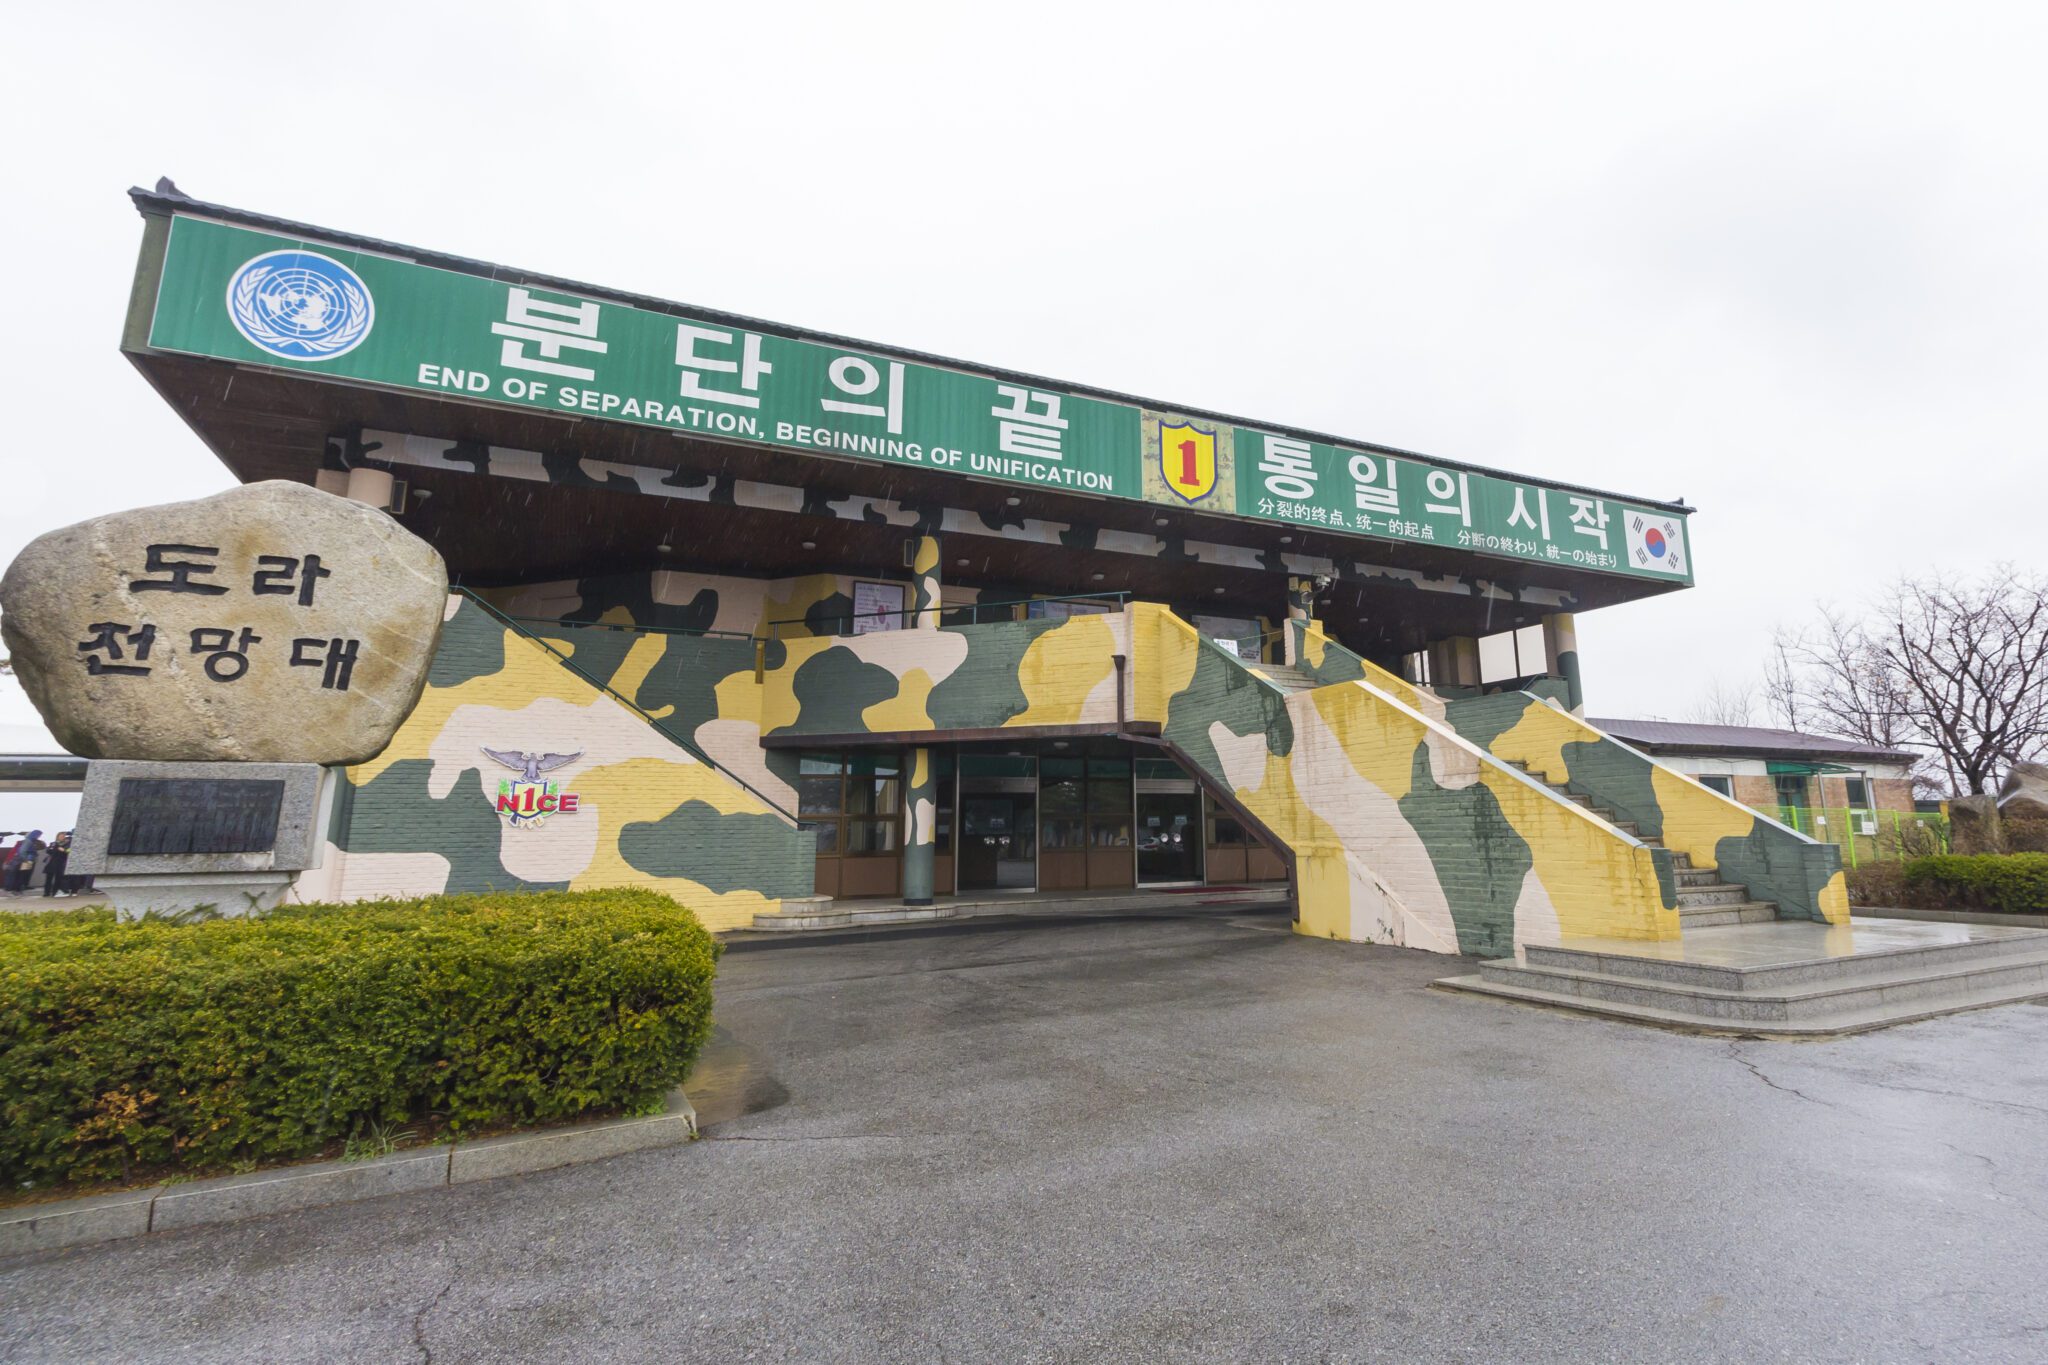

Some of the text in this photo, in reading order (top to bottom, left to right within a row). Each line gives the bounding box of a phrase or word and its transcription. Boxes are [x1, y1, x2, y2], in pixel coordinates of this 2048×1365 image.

[417, 363, 1113, 491] END OF SEPARATION, BEGINNING OF UNIFICATION
[991, 384, 1069, 461] 끝
[1177, 439, 1201, 487] 1
[129, 543, 331, 607] 도라
[78, 621, 360, 691] 전망대
